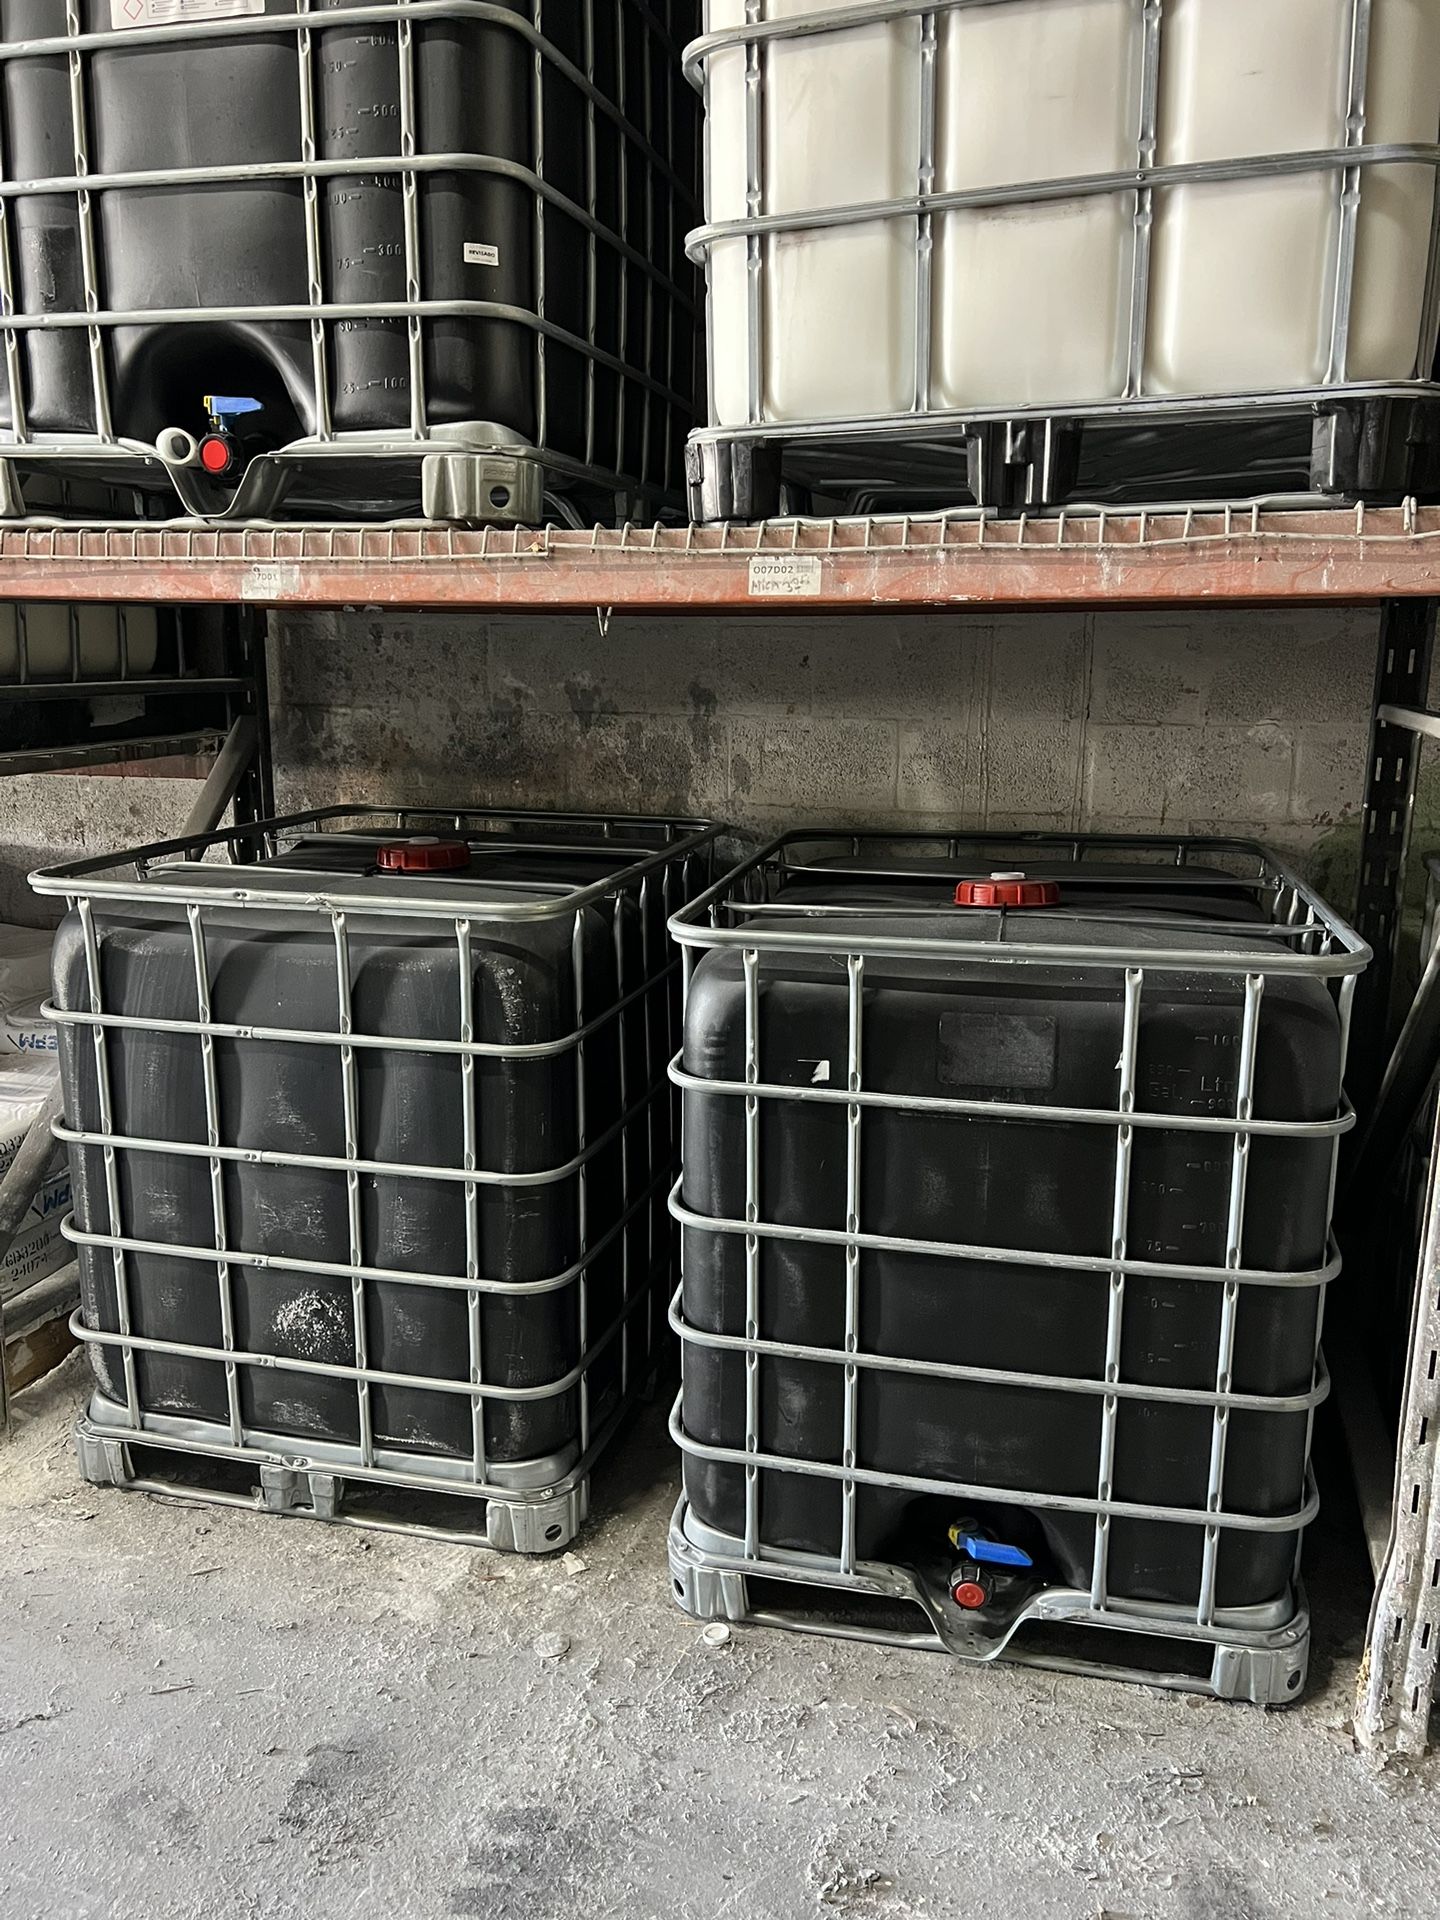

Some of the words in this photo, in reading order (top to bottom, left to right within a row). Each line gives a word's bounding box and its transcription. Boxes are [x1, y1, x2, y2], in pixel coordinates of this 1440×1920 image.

[373, 104, 399, 118] 500
[377, 243, 402, 256] 300
[384, 376, 407, 390] 100
[1213, 1033, 1241, 1047] 100
